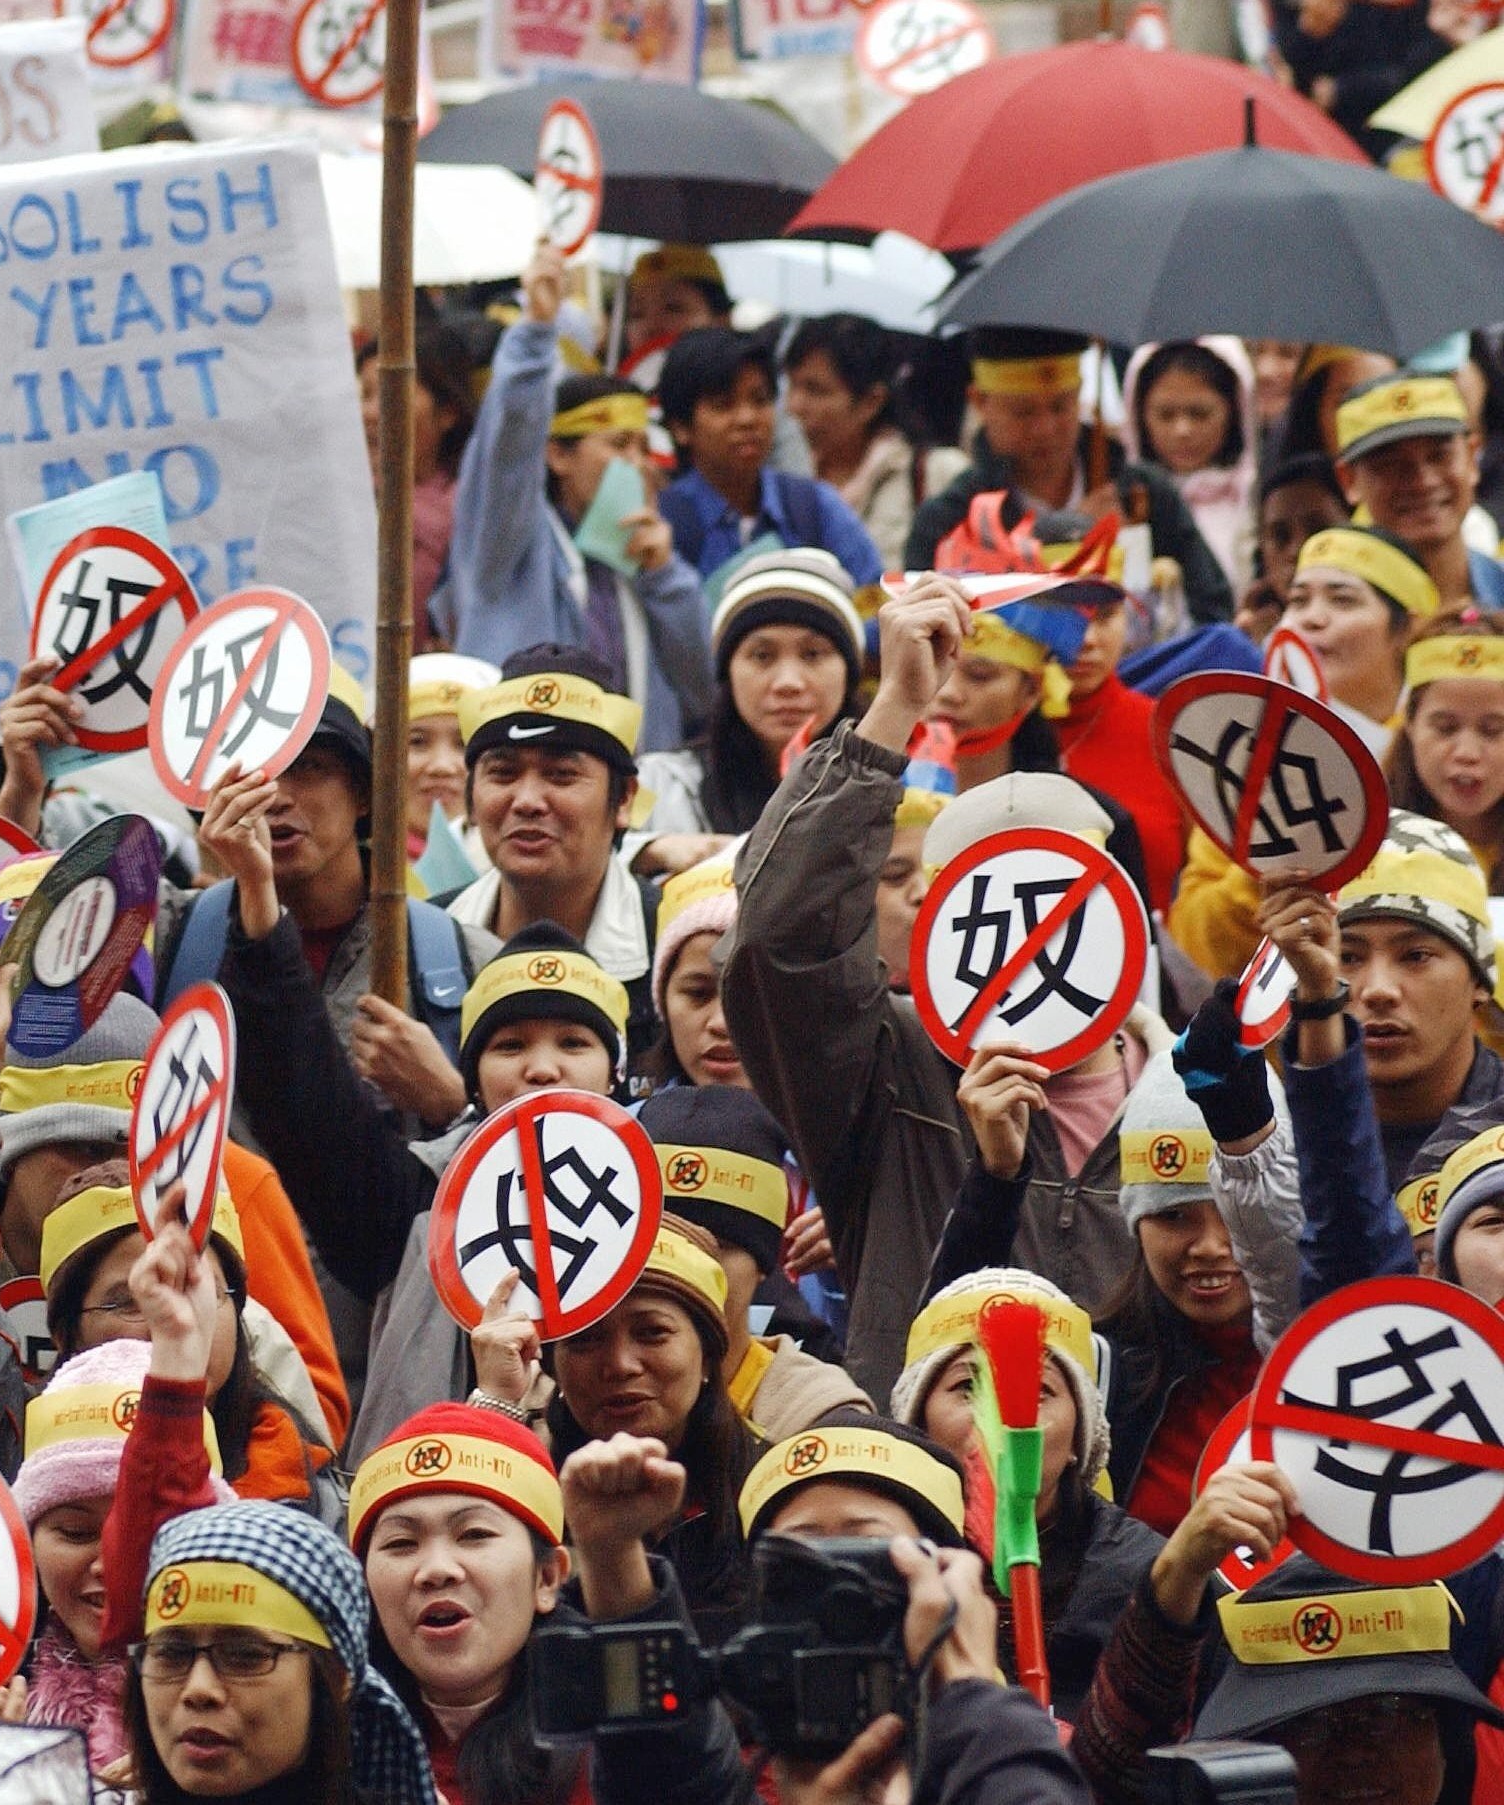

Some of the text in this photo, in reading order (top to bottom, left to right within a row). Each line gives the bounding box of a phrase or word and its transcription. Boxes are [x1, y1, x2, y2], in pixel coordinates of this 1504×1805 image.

[9, 254, 276, 352] YEARS
[52, 560, 152, 706] 奴
[179, 622, 299, 786] 奴
[1170, 708, 1348, 859] 奴
[951, 874, 1110, 1036] 奴
[675, 1156, 702, 1185] 奴
[1156, 1140, 1180, 1170] 奴
[459, 1115, 635, 1309] 奴
[412, 1445, 444, 1470] 奴
[458, 1451, 513, 1479] Anti-WTO
[792, 1442, 891, 1467] 奴 Anti-WTO
[1283, 1326, 1504, 1555] 奴
[195, 1582, 257, 1606] Anti-WTO
[1300, 1610, 1334, 1646] 奴
[1348, 1610, 1404, 1635] Anti-WTO
